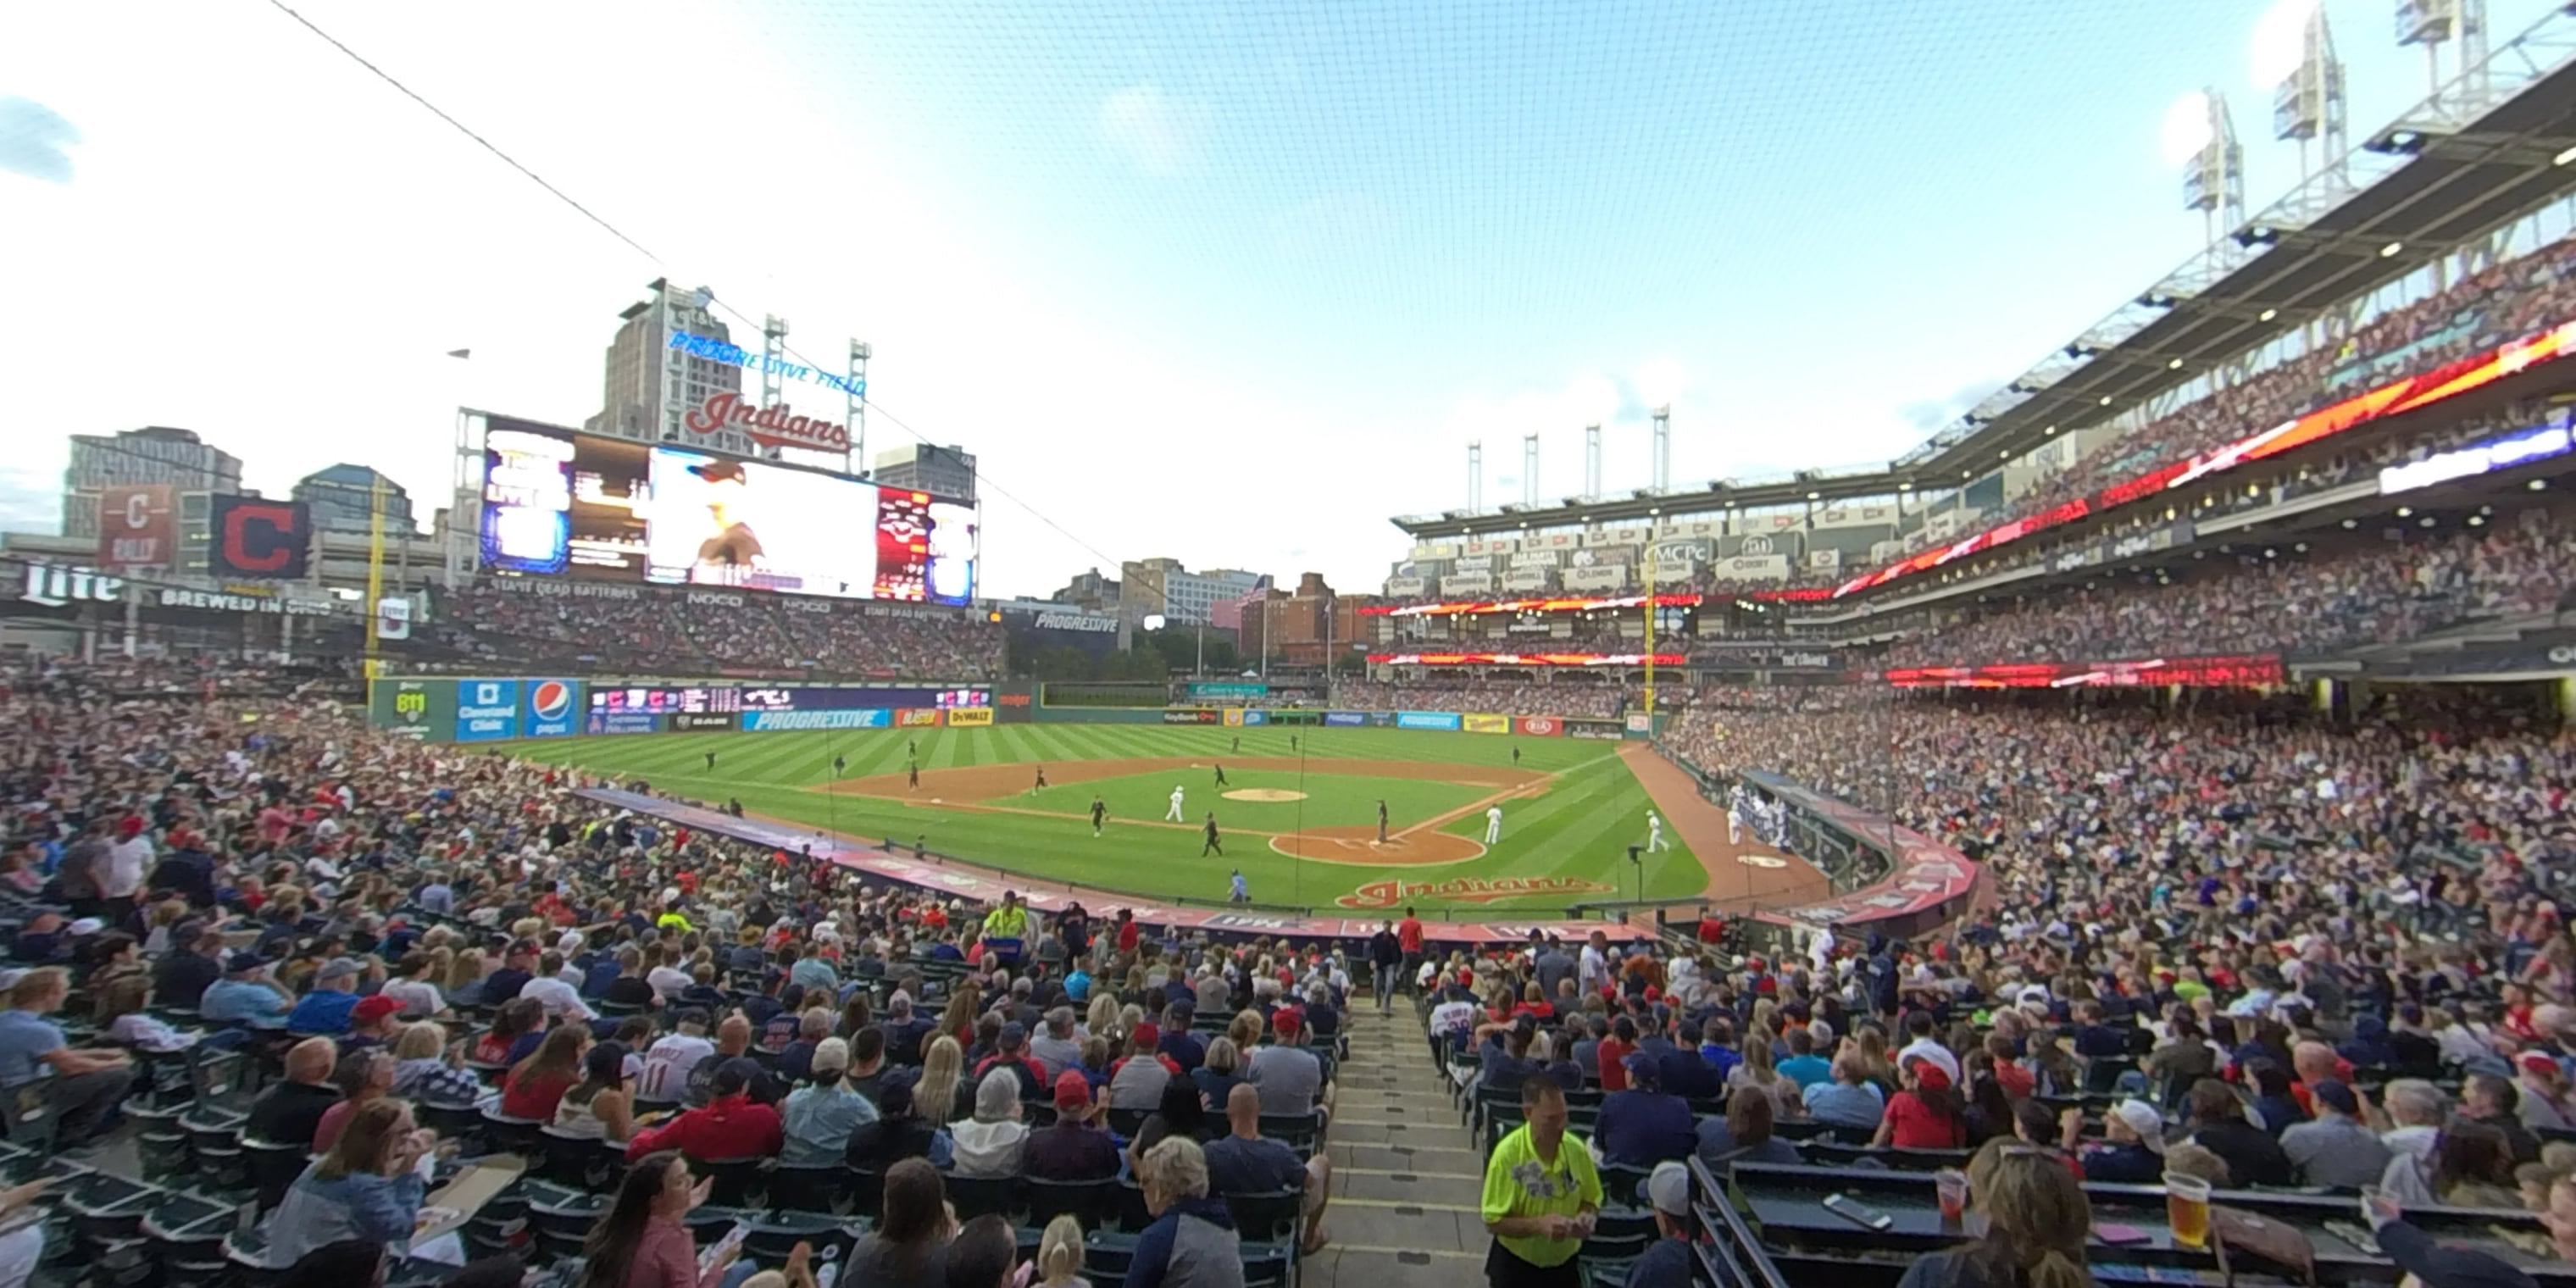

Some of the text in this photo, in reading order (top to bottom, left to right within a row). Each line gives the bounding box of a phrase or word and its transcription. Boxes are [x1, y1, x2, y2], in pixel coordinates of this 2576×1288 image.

[685, 392, 850, 451] Indians
[127, 494, 149, 529] C
[224, 505, 293, 570] C
[20, 557, 125, 607] Lite
[161, 589, 256, 612] BREWED
[1035, 613, 1119, 633] PROGRESSIVE
[753, 709, 876, 730] PROGRESSIVE
[1528, 721, 1550, 731] KIA
[1335, 878, 1617, 908] Indians
[644, 1063, 668, 1097] 11
